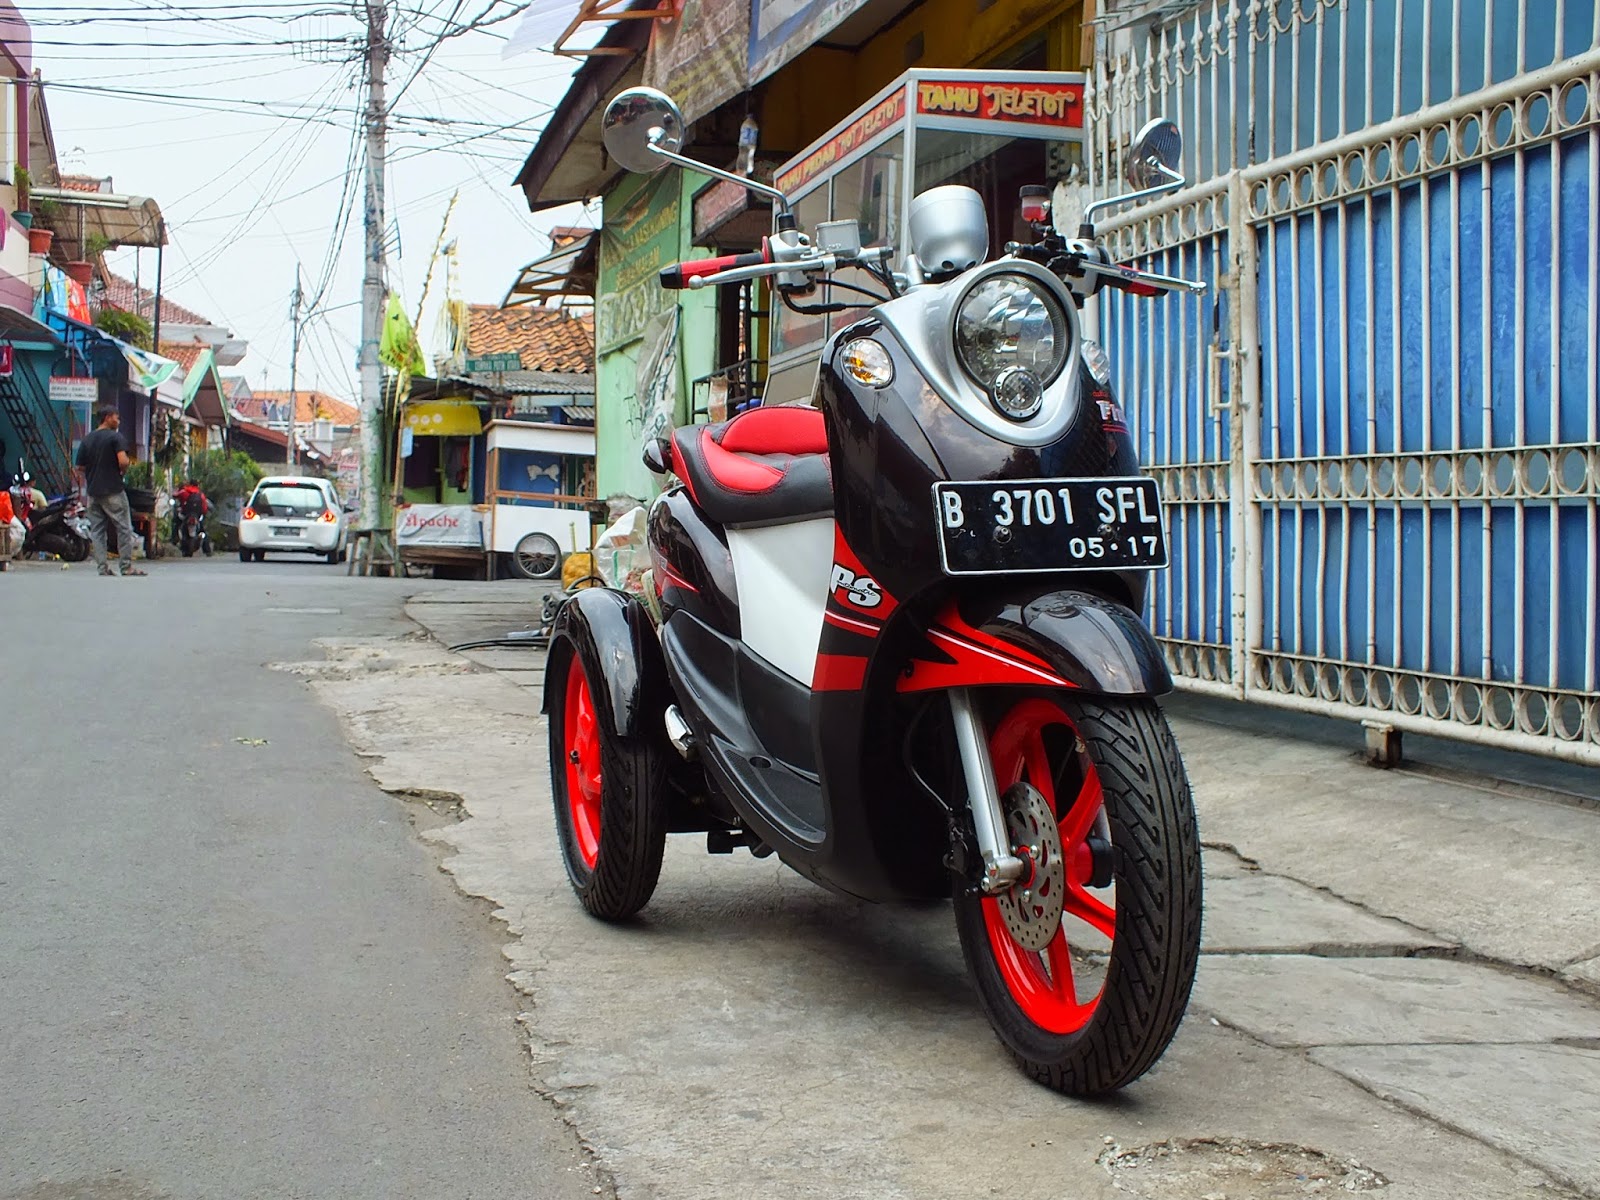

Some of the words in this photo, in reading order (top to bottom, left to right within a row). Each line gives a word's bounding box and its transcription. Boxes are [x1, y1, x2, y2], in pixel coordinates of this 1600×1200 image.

[918, 84, 979, 113] TAHU
[983, 85, 1075, 119] JELETOT
[405, 513, 460, 528] Apache
[942, 491, 965, 528] B
[992, 488, 1074, 526] 3701
[1095, 486, 1158, 524] SFL
[830, 563, 882, 607] PS
